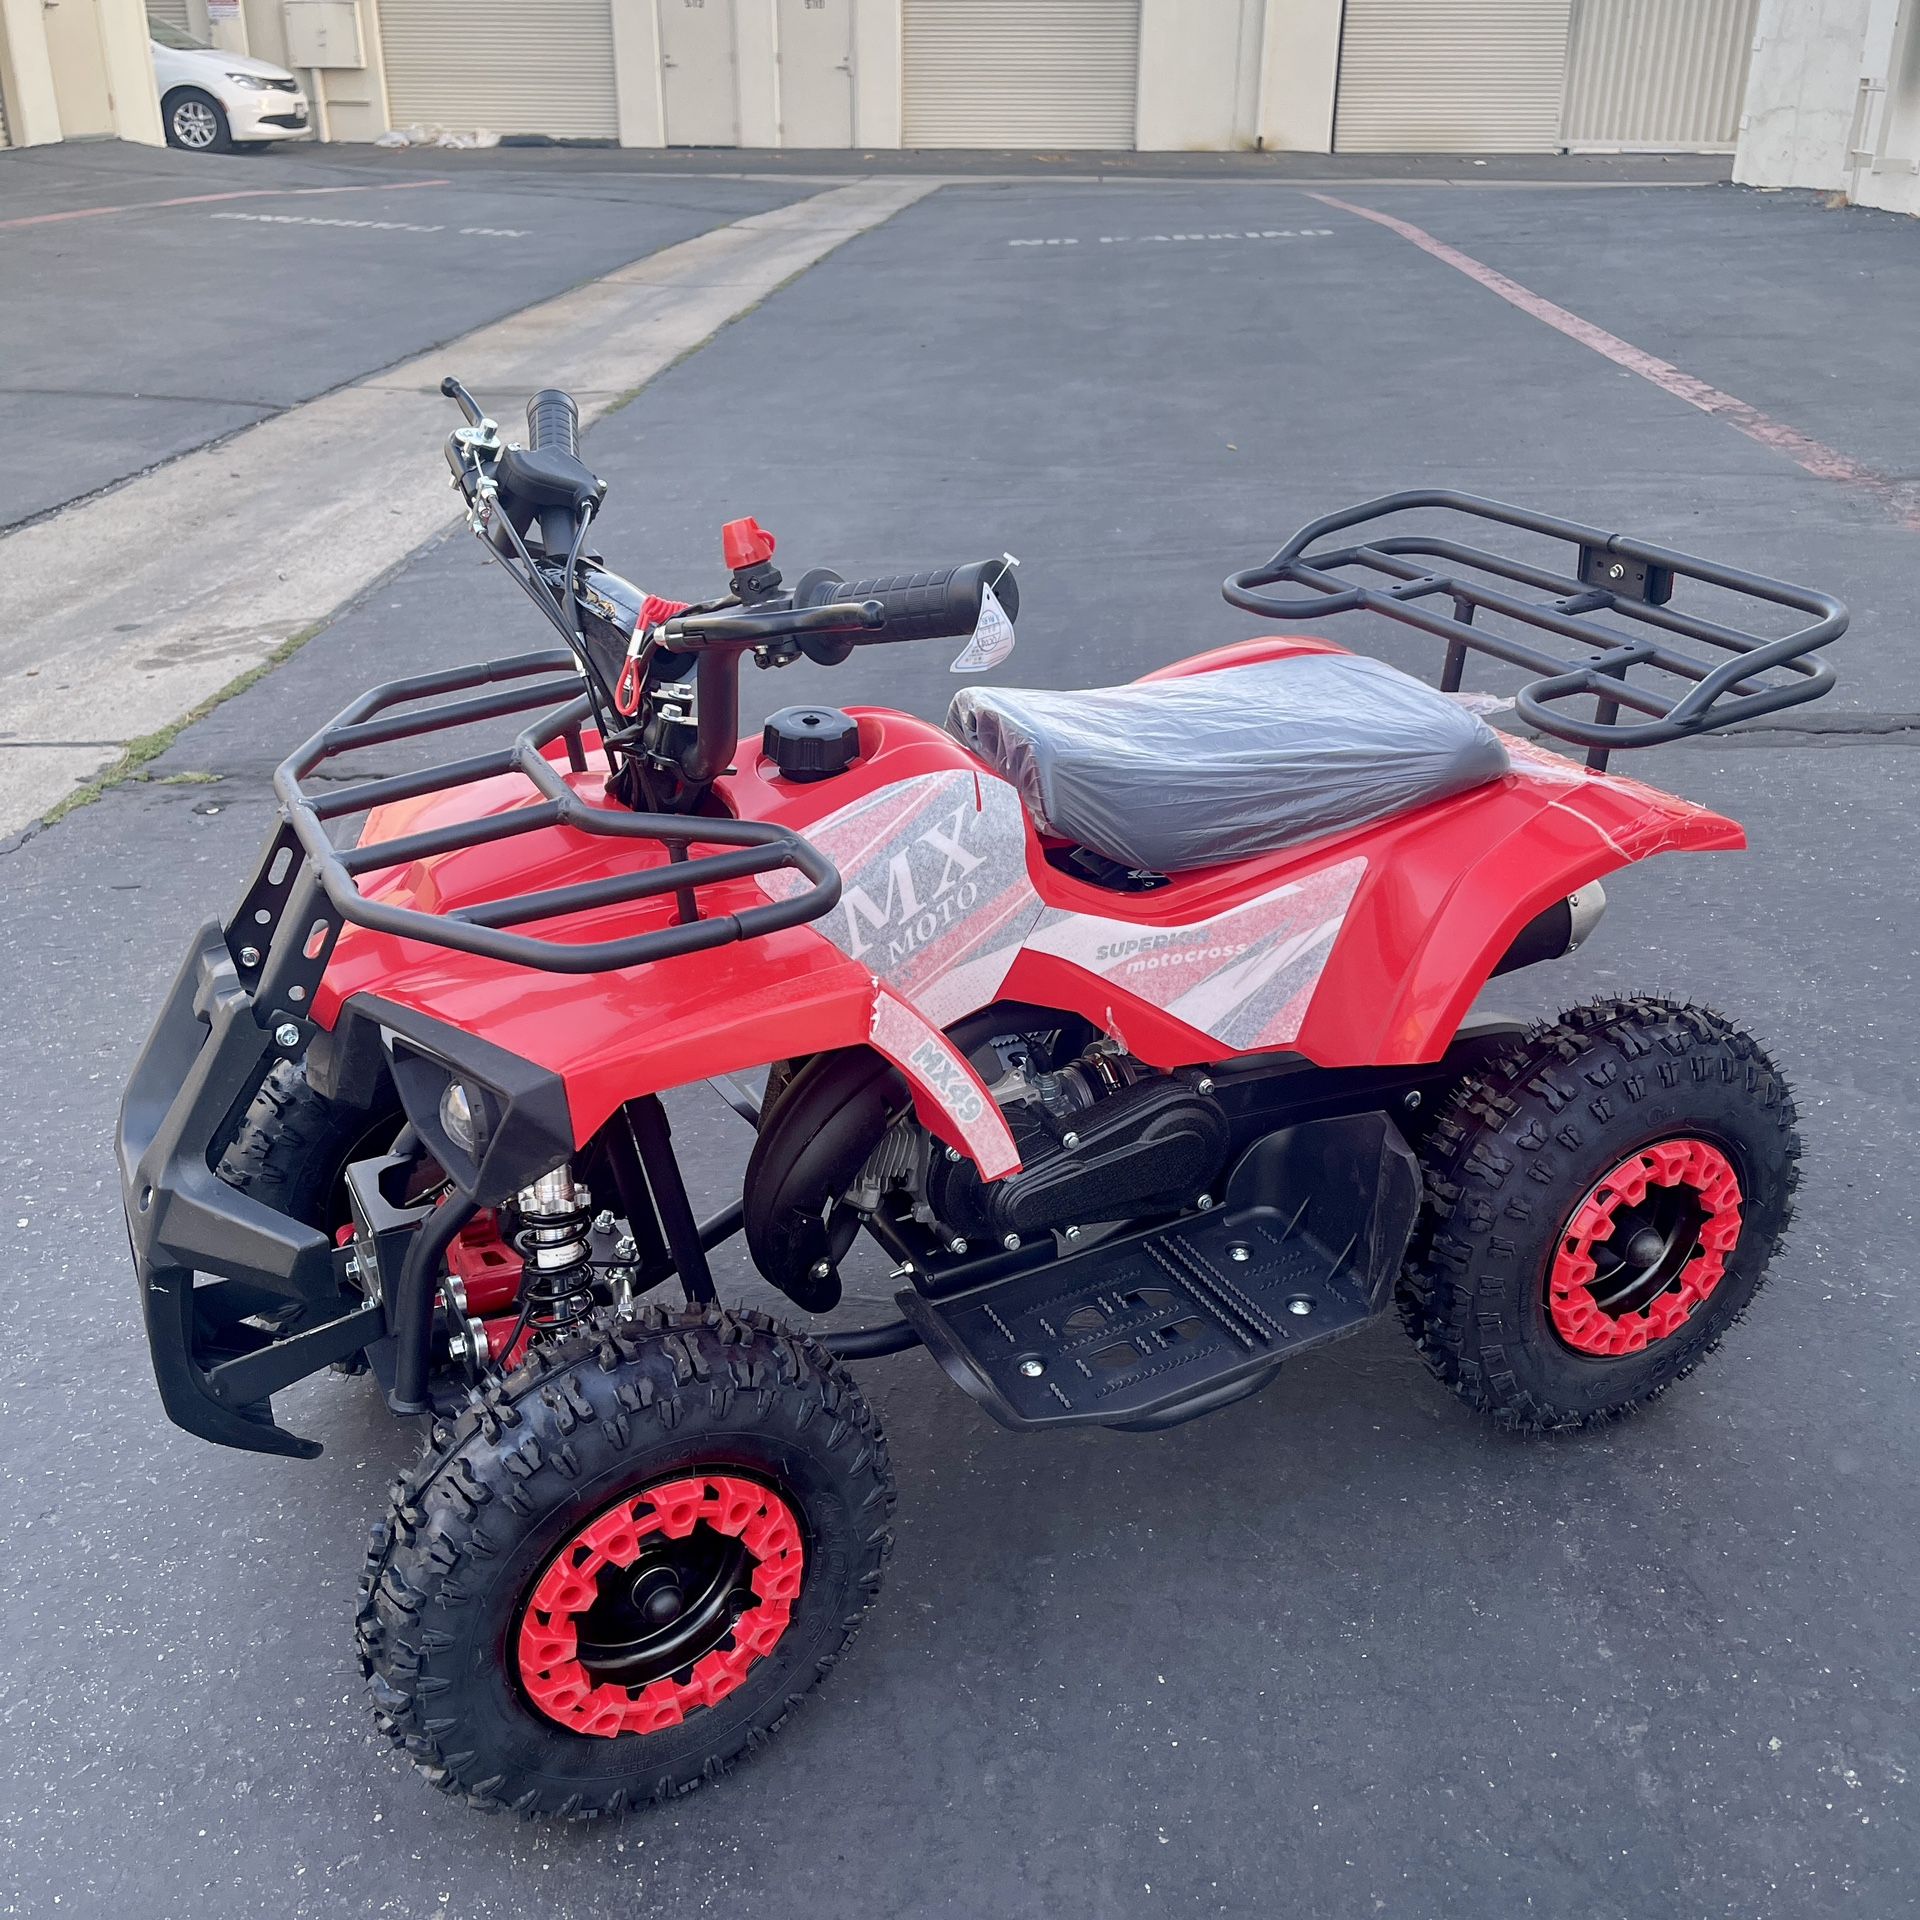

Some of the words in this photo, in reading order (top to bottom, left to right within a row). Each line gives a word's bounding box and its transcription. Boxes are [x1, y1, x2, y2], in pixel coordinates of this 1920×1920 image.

[1007, 238, 1080, 247] NO
[1098, 229, 1335, 243] PARKING
[839, 801, 988, 961] MX
[887, 881, 978, 966] MOTO
[1125, 942, 1248, 975] motocross
[909, 1038, 983, 1123] MX49
